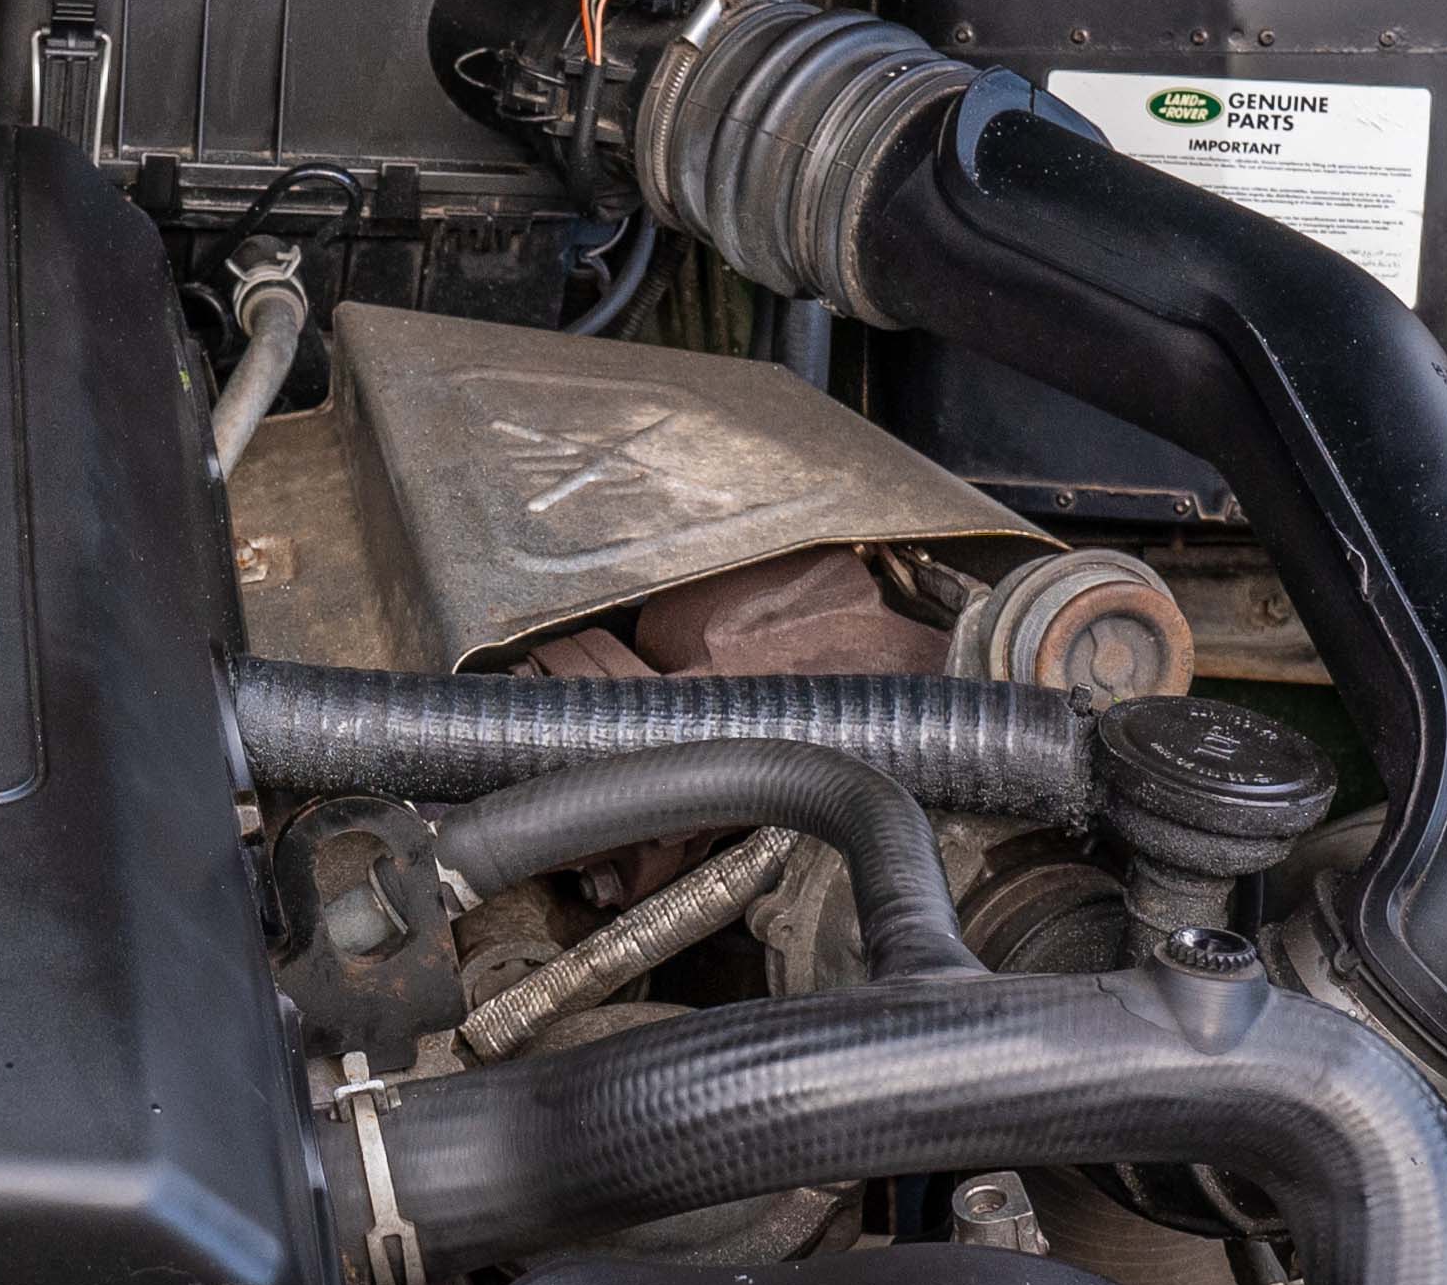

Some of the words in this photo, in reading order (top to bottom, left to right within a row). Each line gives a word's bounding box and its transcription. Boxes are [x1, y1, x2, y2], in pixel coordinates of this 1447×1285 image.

[1228, 92, 1329, 114] GENUINE
[1227, 113, 1295, 131] PARTS
[1188, 138, 1282, 156] IMPORTANT
